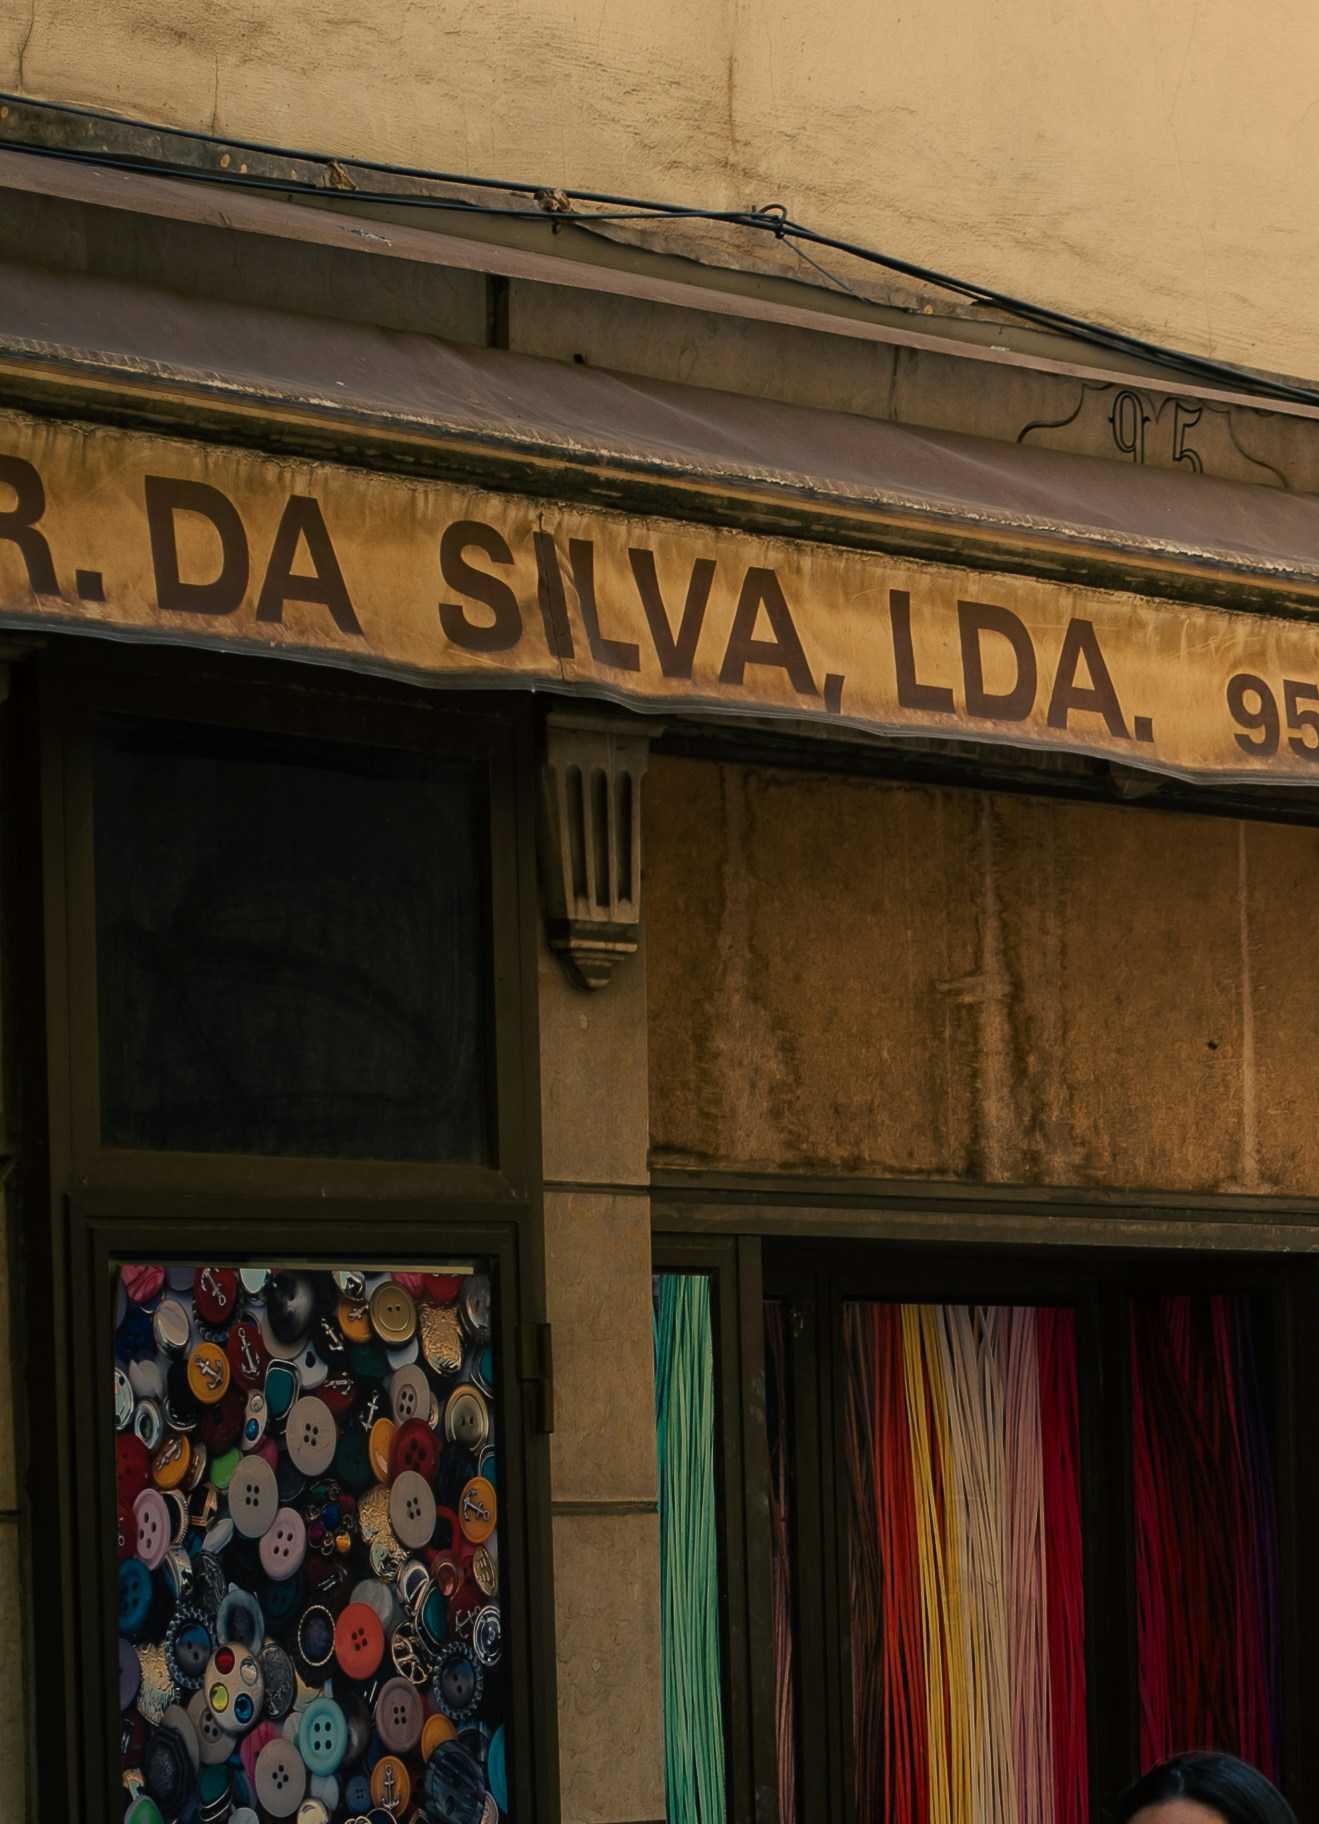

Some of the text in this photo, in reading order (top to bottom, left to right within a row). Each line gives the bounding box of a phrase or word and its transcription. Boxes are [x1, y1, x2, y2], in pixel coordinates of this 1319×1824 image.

[1108, 389, 1205, 474] 95
[144, 474, 365, 636] DA
[438, 519, 846, 714] SILVA,
[889, 588, 1154, 744] LDA.
